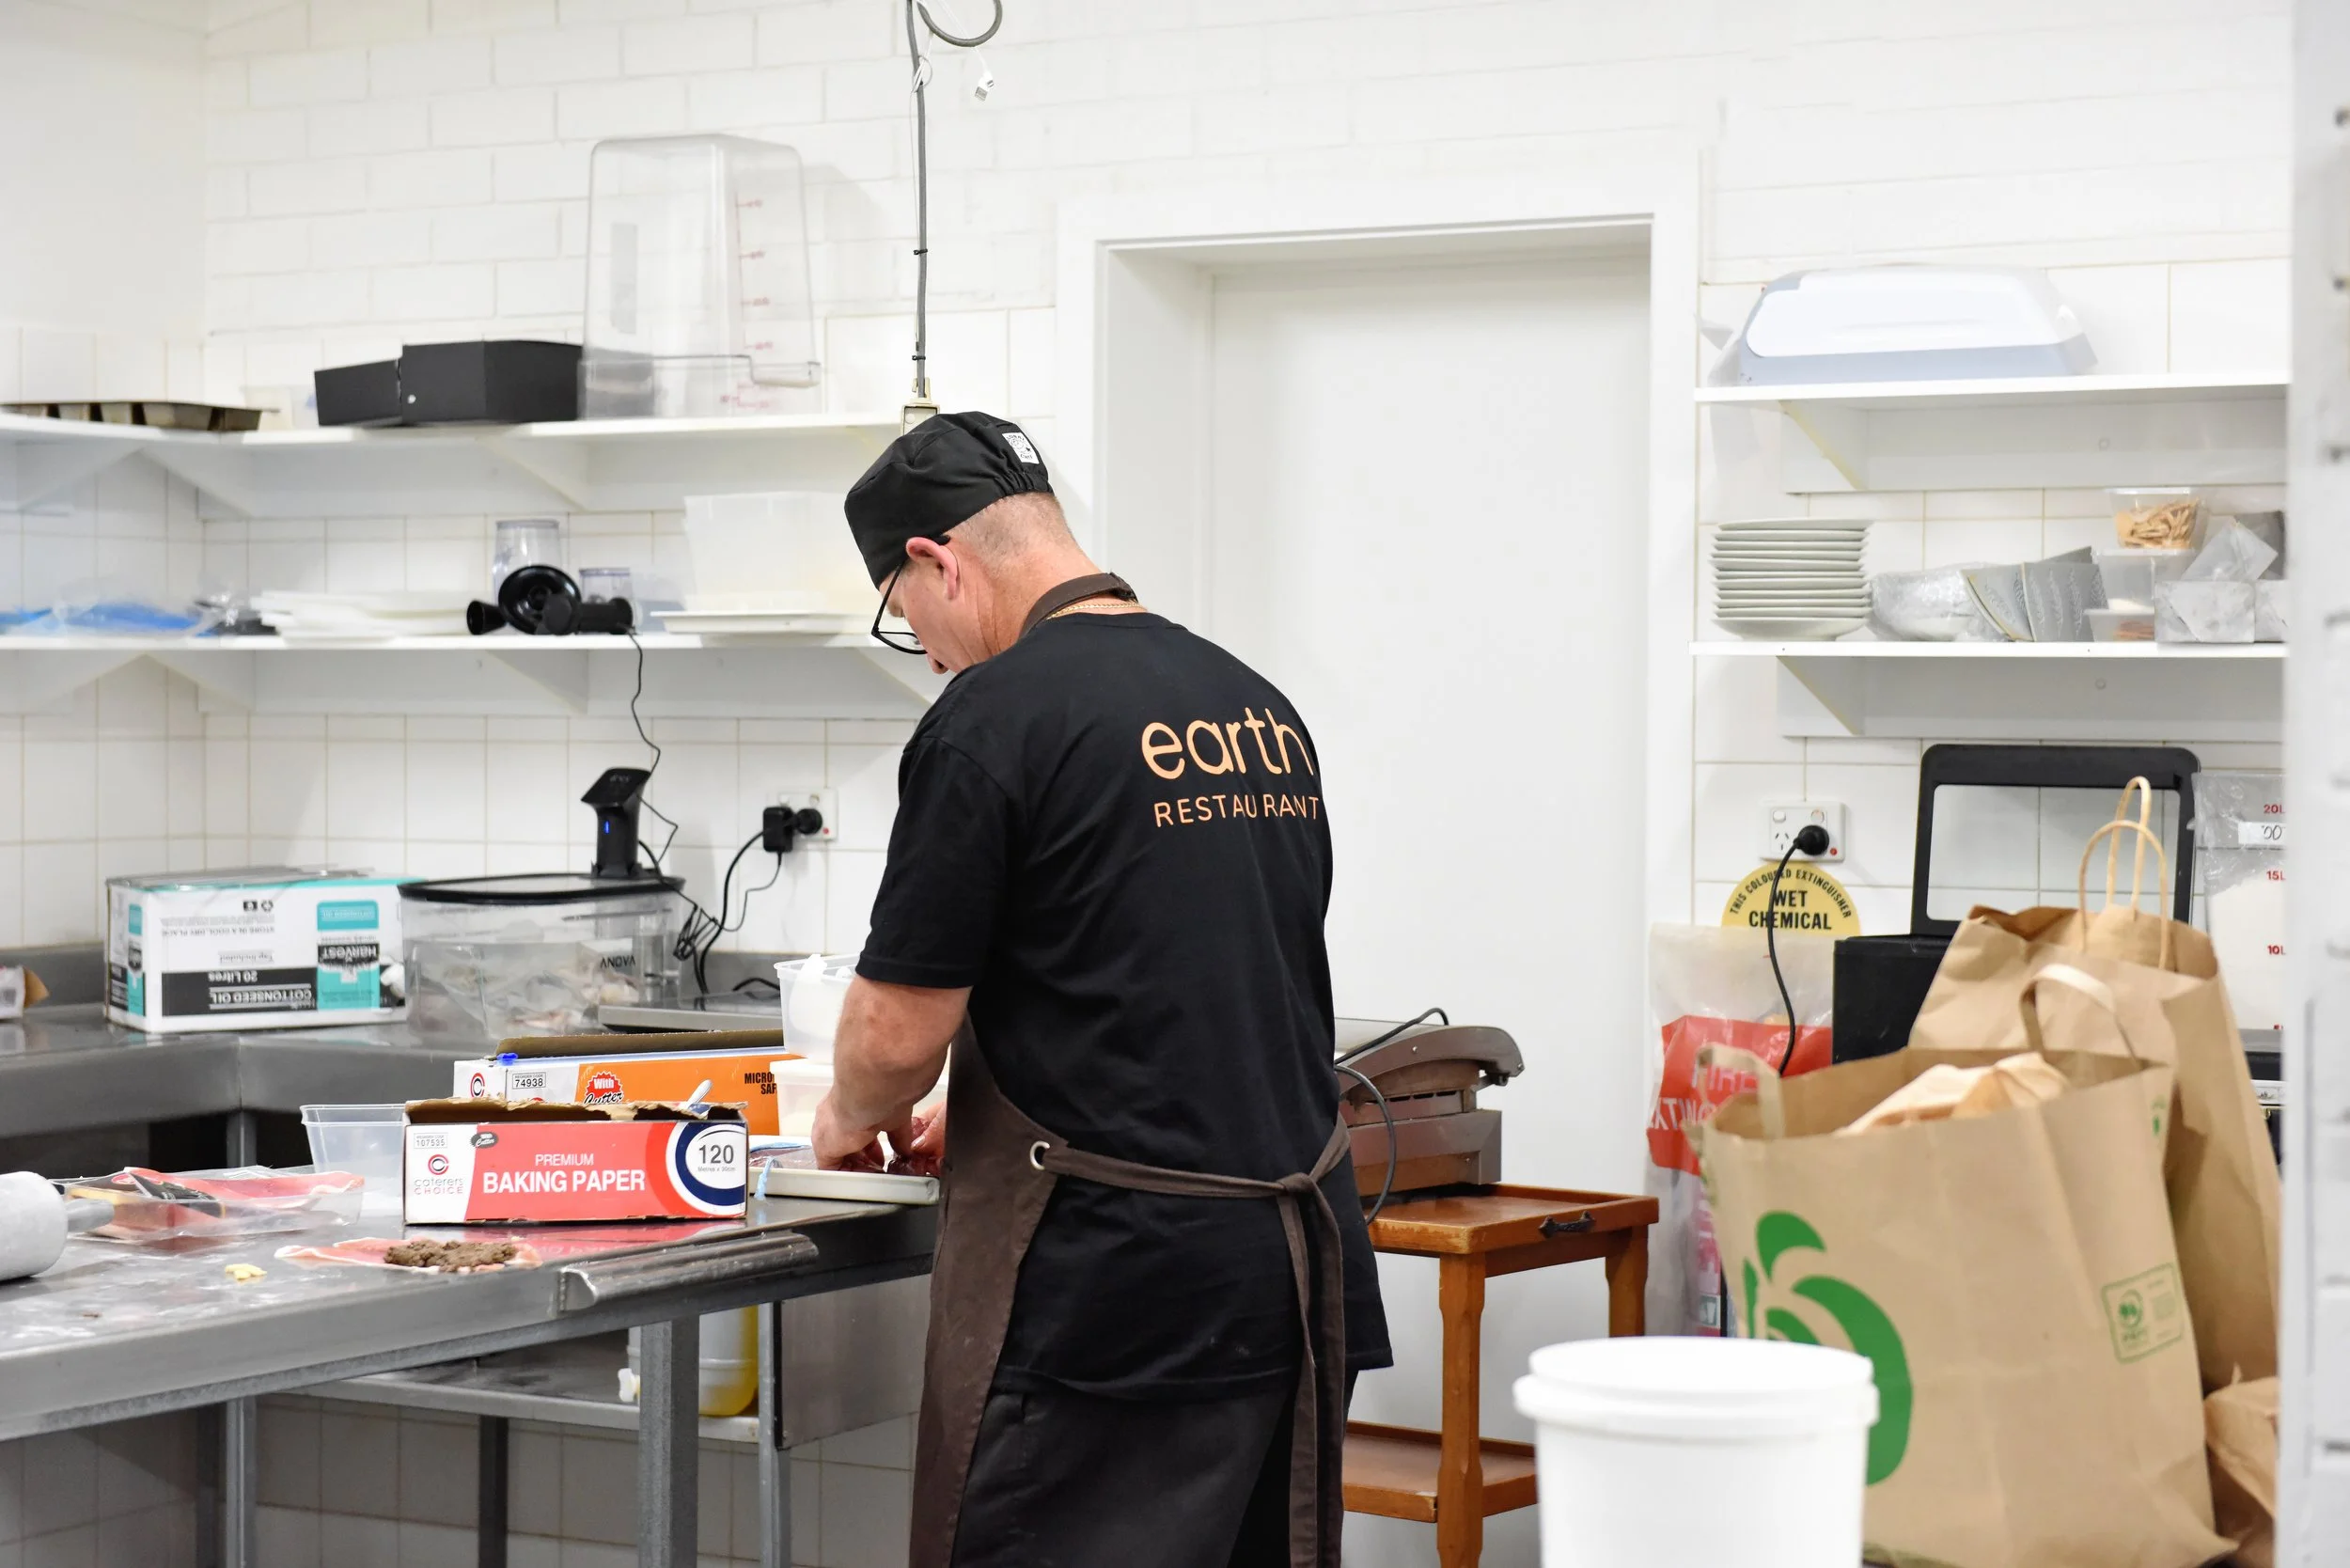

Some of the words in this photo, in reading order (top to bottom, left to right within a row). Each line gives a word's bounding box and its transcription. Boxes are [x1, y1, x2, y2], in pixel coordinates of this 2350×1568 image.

[1141, 707, 1313, 779] earth
[1154, 793, 1319, 827] RESTAURANT
[1730, 893, 1747, 914] THIS
[1796, 870, 1852, 917] EXTINGUISHER
[1772, 890, 1808, 907] WET
[1749, 910, 1832, 930] CHEMICAL
[601, 955, 636, 968] ANOVA
[208, 971, 242, 983] Litres
[243, 970, 258, 982] 20
[210, 992, 231, 1004] OIL
[232, 989, 312, 1004] COTTONSEED
[515, 1077, 543, 1088] 74938
[594, 1078, 614, 1090] With
[744, 1072, 775, 1084] MICRO
[760, 1083, 777, 1094] SAF
[535, 1153, 594, 1167] PREMIUM
[698, 1144, 734, 1164] 120
[415, 1178, 463, 1186] caterers
[482, 1170, 567, 1194] BAKING
[572, 1169, 646, 1192] PAPER
